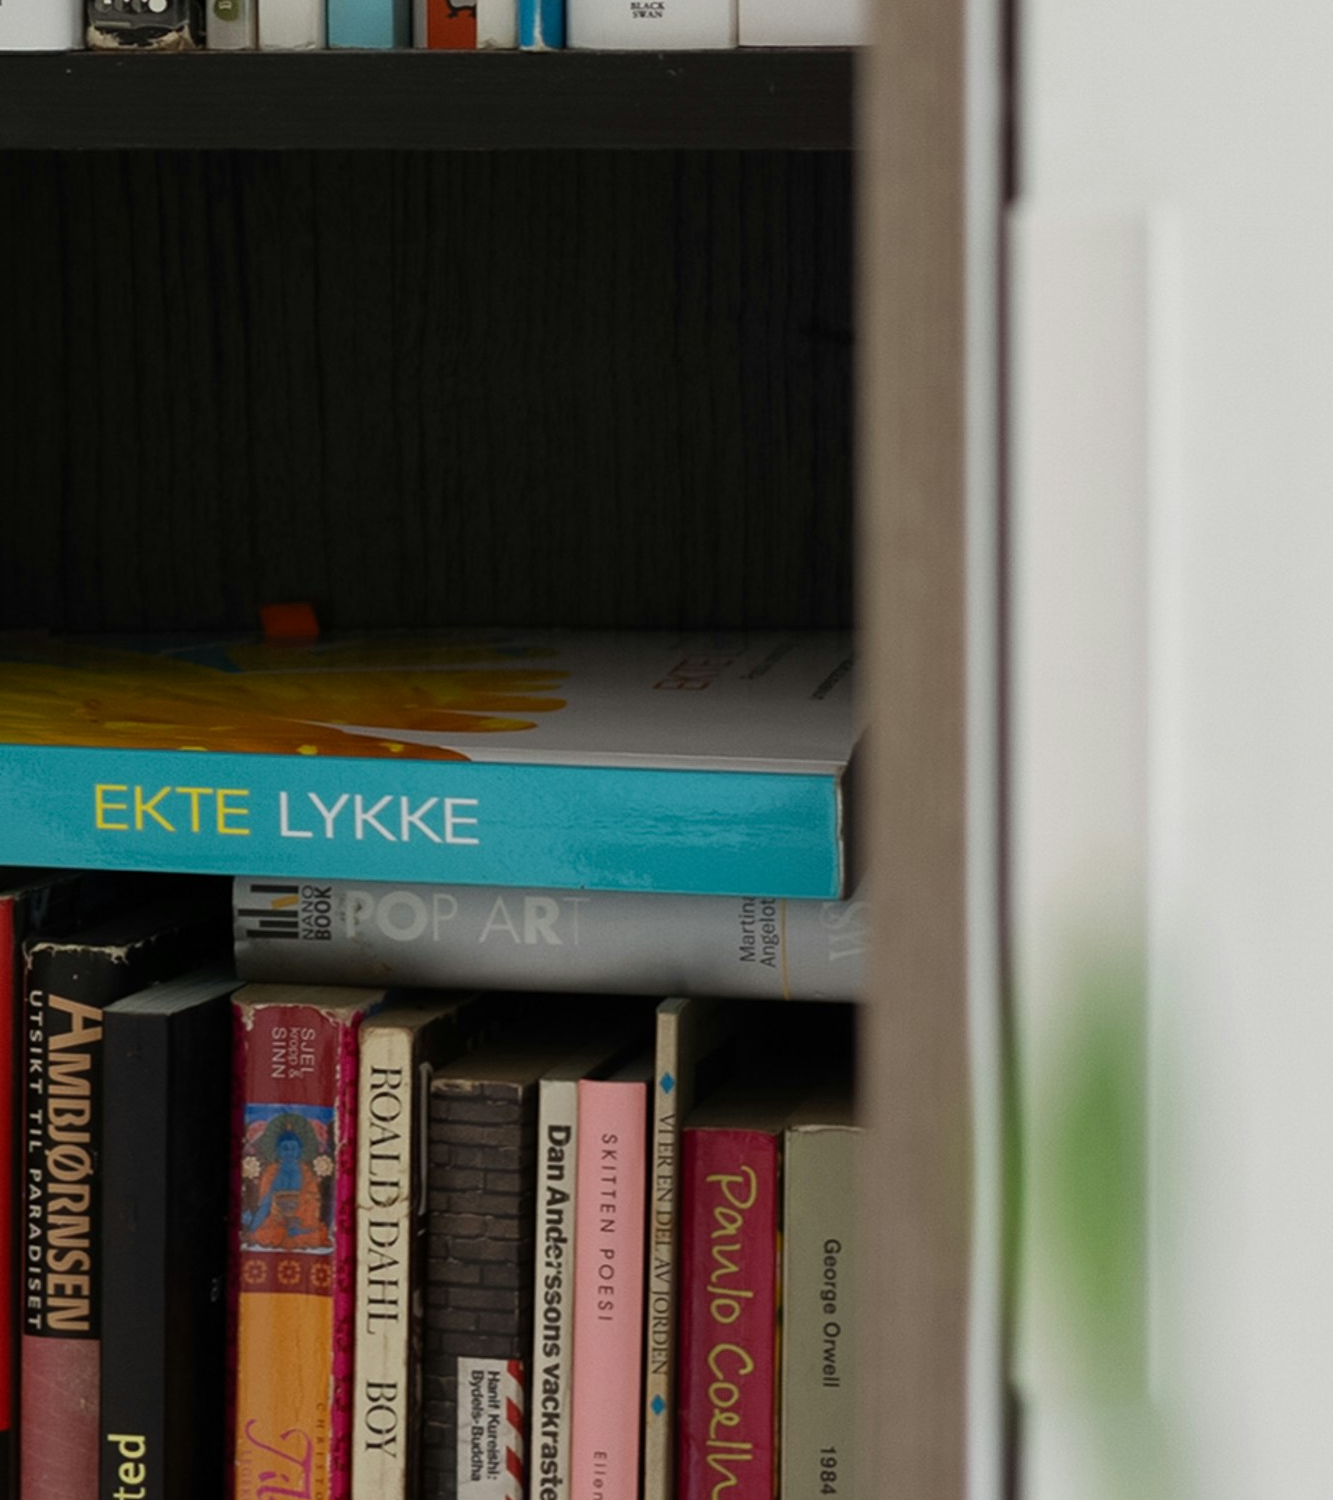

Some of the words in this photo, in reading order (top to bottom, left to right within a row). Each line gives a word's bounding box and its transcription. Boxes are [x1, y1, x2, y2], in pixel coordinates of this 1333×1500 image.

[94, 782, 251, 835] EKTE
[278, 790, 480, 846] LYKKE
[345, 890, 457, 942] POP
[478, 896, 591, 946] ART
[29, 989, 44, 1091] UTSIKT
[28, 1108, 43, 1154] TIL
[367, 1065, 403, 1208] ROALD
[546, 1124, 570, 1180] Dan
[656, 1139, 674, 1168] ER
[657, 1113, 675, 1134] VI
[44, 994, 103, 1332] AMBJØRNSEN
[599, 1133, 618, 1234] SKITTEN
[655, 1174, 673, 1203] EN
[27, 1167, 43, 1331] PARADISET
[654, 1210, 673, 1251] DEL
[707, 1166, 757, 1324] Paulo
[366, 1220, 400, 1336] DAHL
[543, 1186, 569, 1358] Anderssons
[597, 1249, 615, 1322] POESI
[654, 1257, 672, 1282] AV
[820, 1238, 843, 1316] George
[652, 1289, 671, 1375] JORDEN
[822, 1322, 842, 1388] Orwell
[364, 1380, 399, 1460] BOY
[486, 1371, 500, 1410] Hanif
[469, 1370, 485, 1482] Bydels-Buddha
[486, 1414, 501, 1481] Kureishi:
[819, 1446, 838, 1496] 1984
